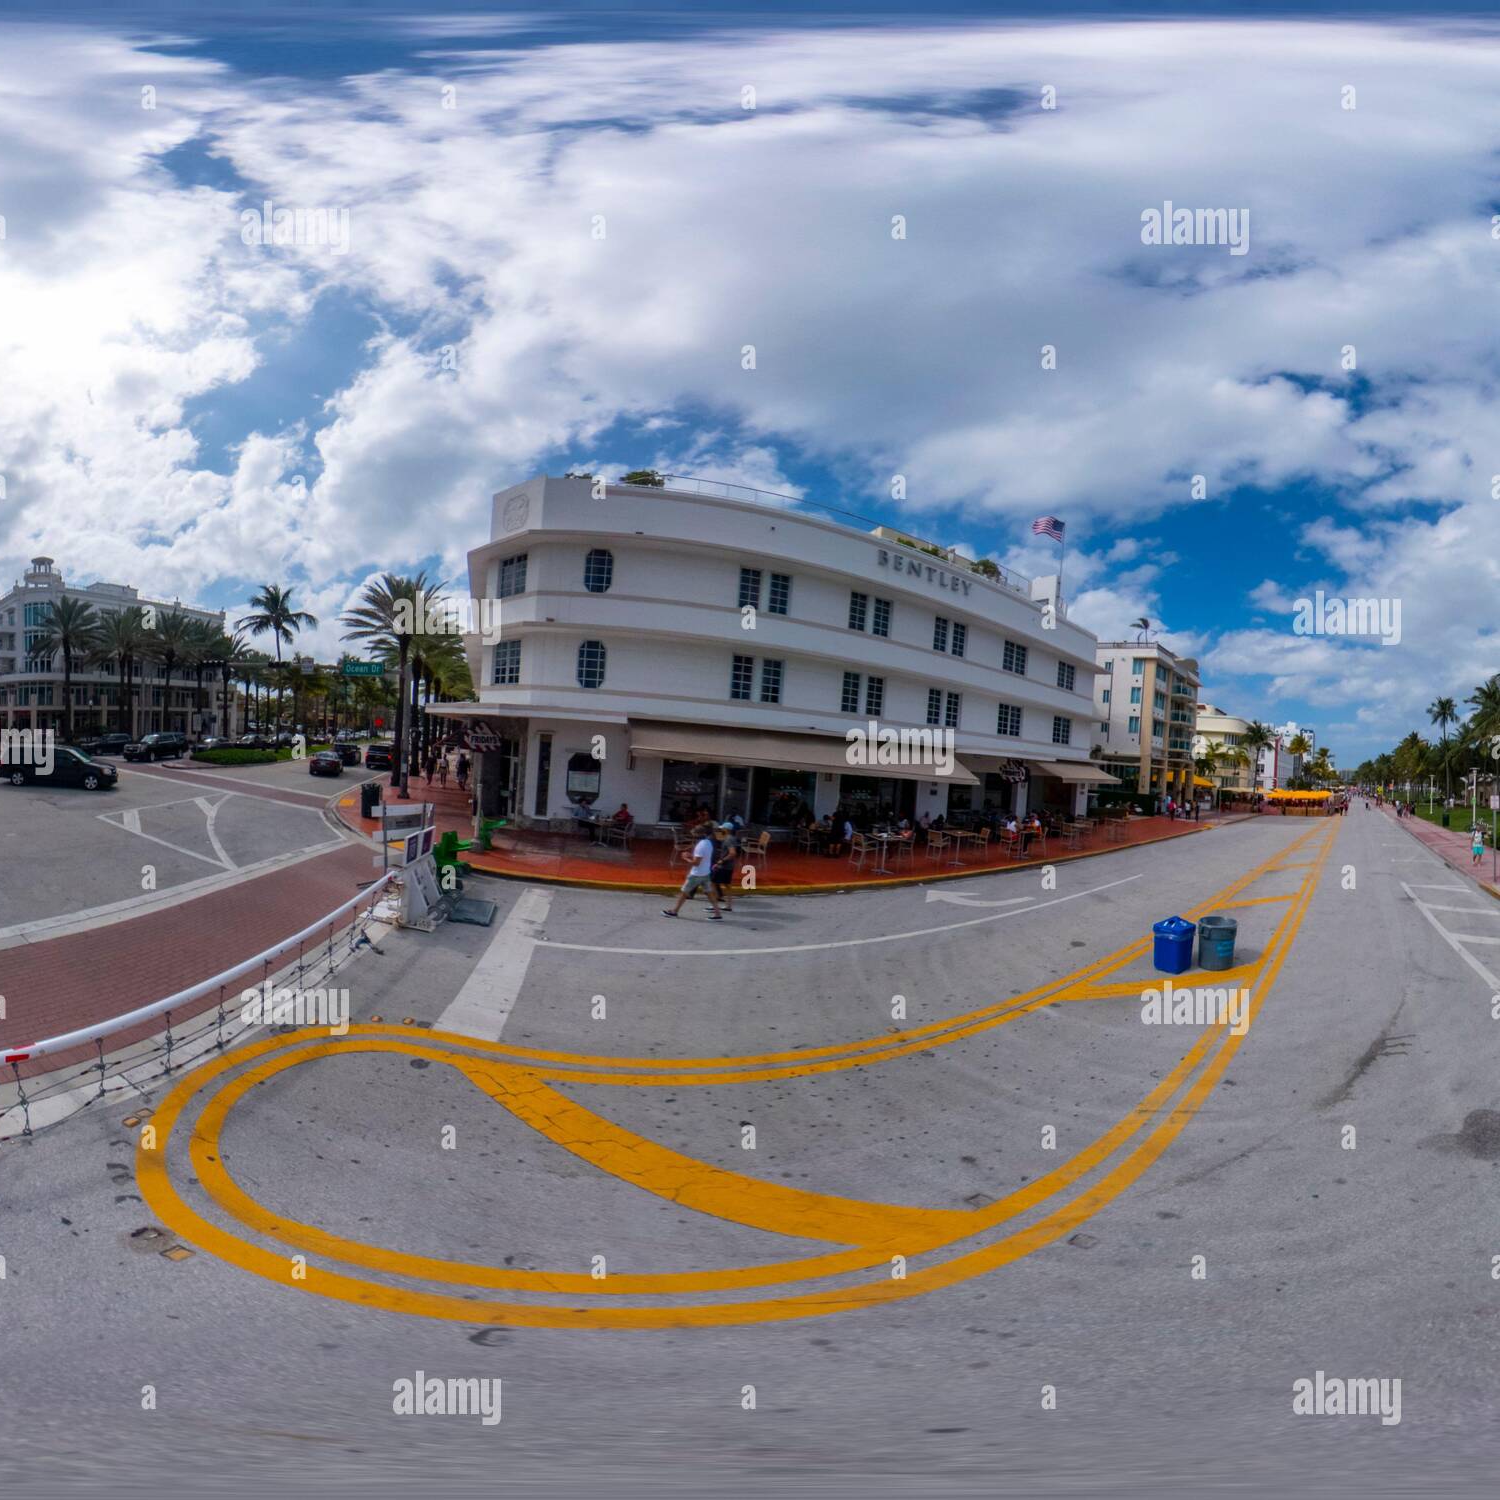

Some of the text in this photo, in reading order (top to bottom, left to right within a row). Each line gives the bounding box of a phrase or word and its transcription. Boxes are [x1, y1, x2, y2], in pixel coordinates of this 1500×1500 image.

[878, 549, 972, 597] BENTLEY
[346, 664, 380, 673] Ocean Dr
